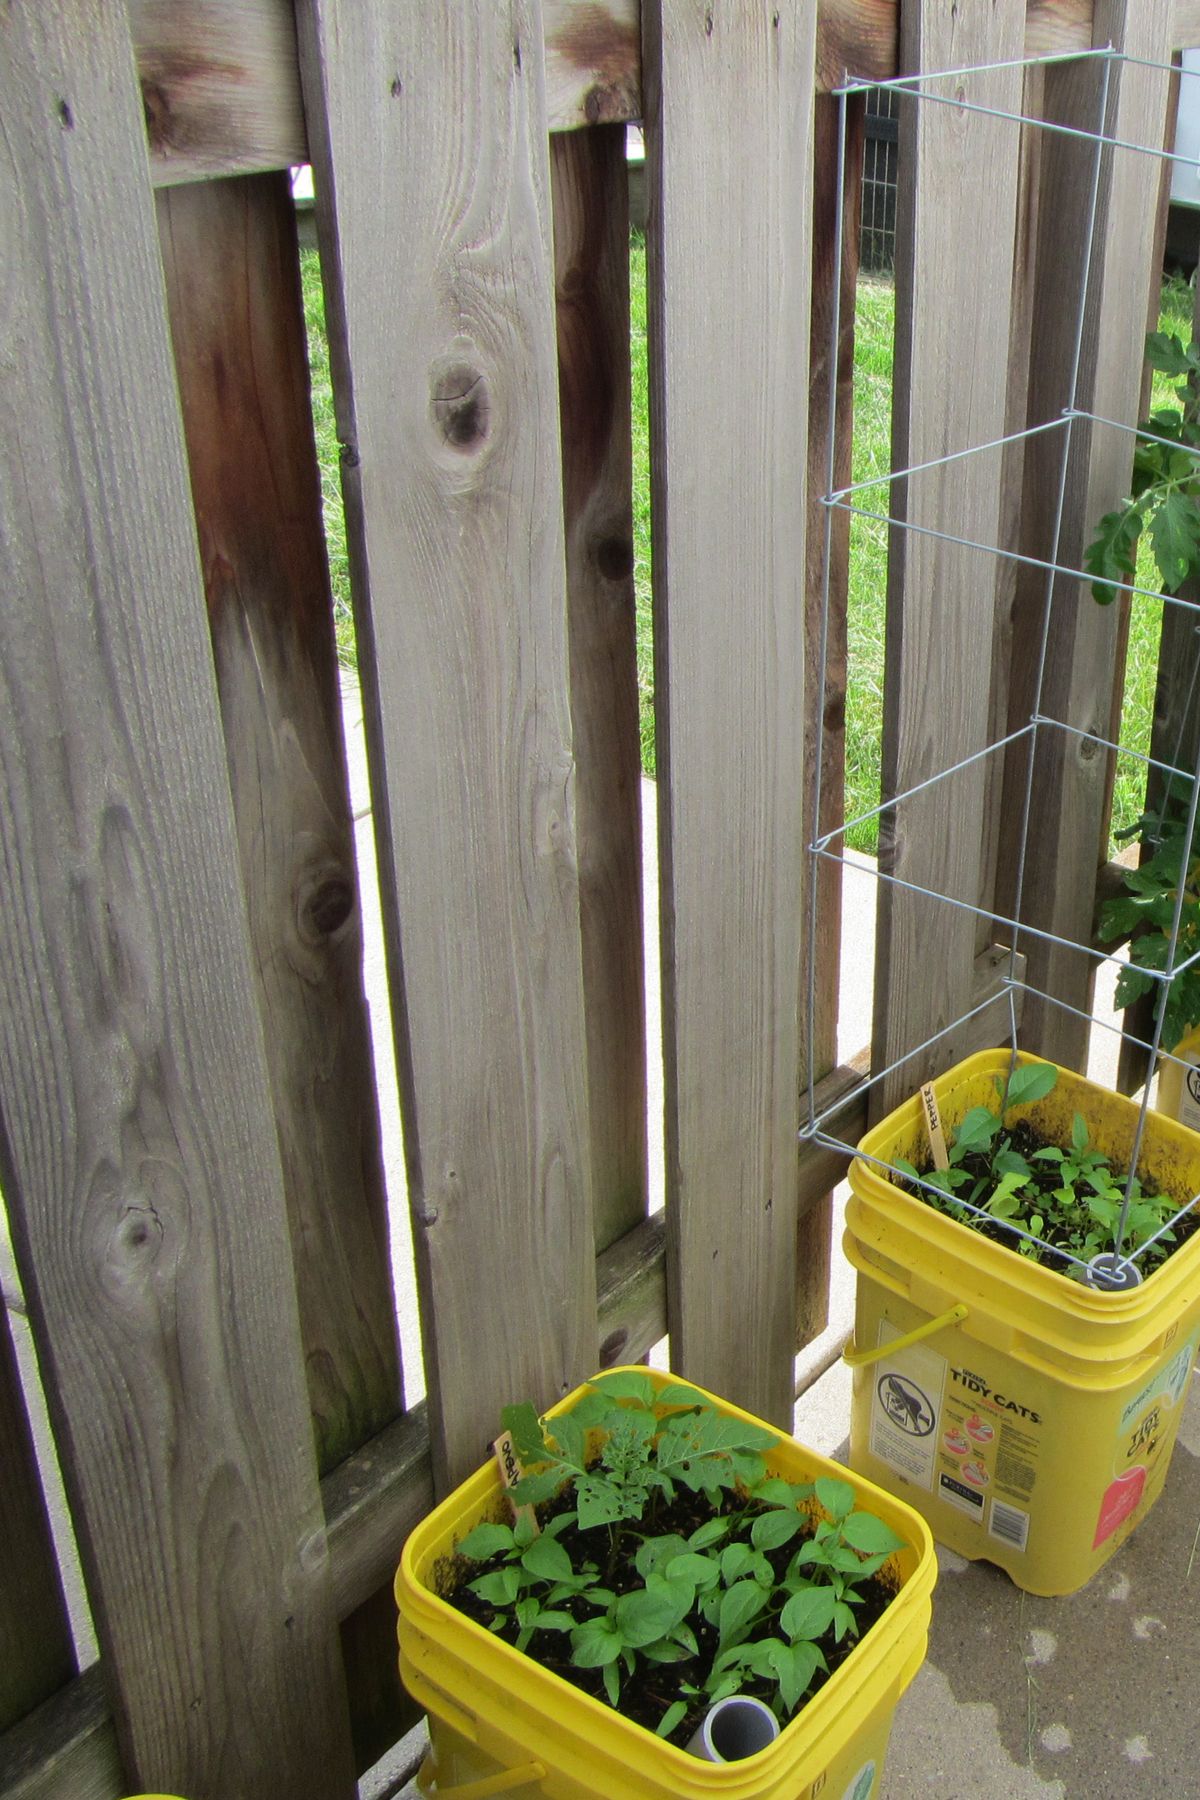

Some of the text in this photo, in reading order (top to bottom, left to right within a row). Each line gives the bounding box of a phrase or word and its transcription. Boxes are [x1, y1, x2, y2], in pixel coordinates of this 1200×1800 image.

[924, 1085, 938, 1132] PEPPER
[950, 1367, 992, 1397] TIDY
[993, 1394, 1042, 1424] CATS
[502, 1440, 520, 1487] APENO
